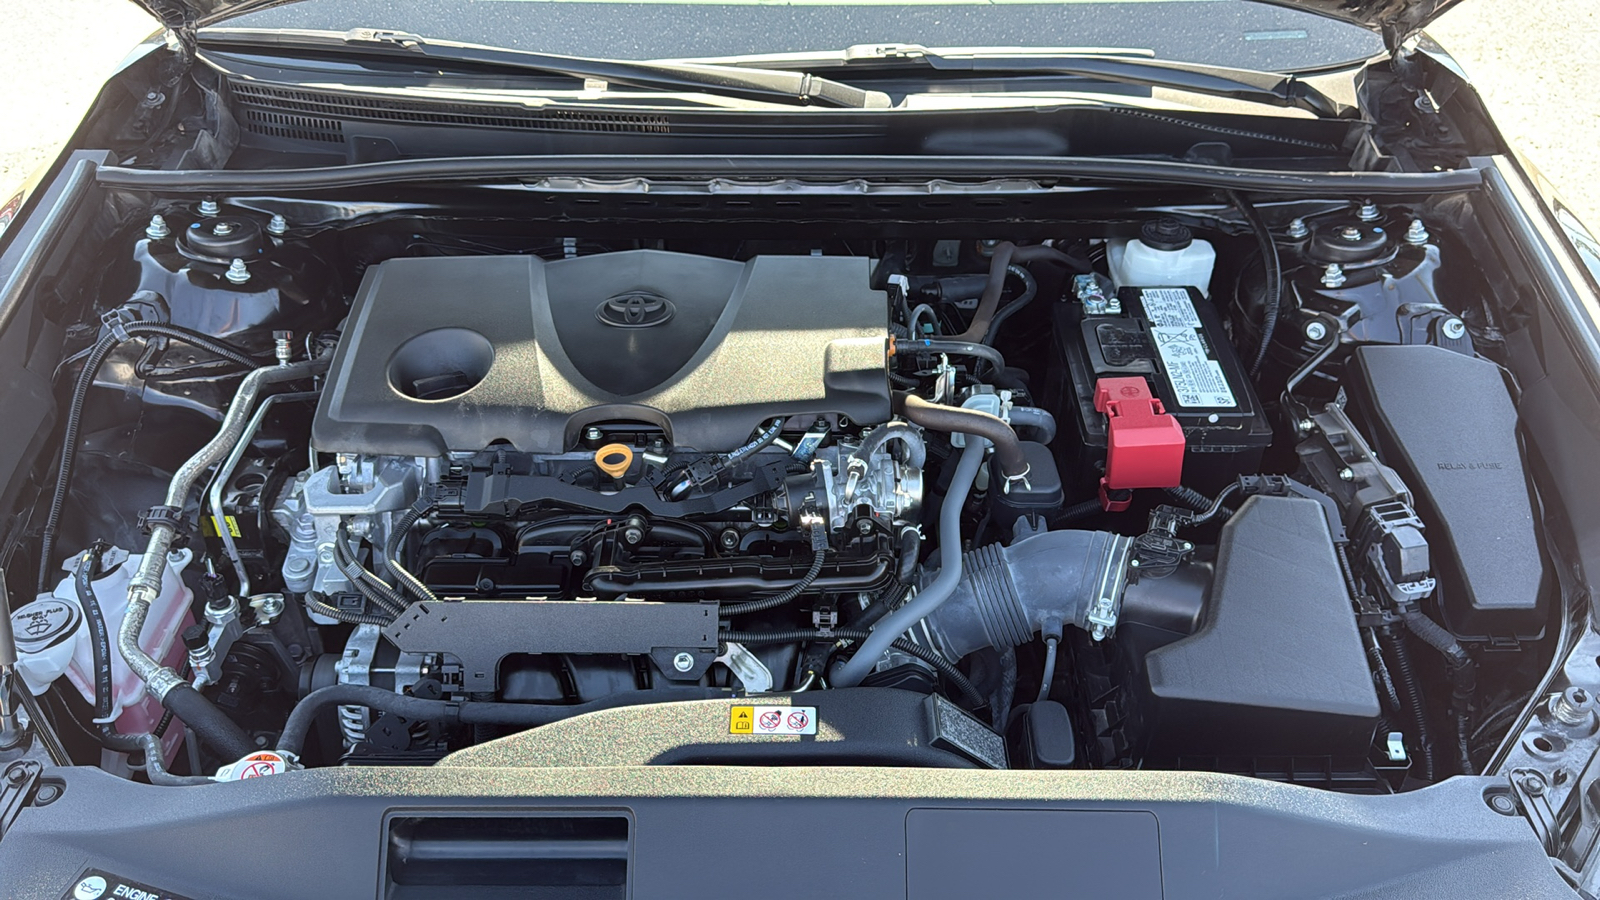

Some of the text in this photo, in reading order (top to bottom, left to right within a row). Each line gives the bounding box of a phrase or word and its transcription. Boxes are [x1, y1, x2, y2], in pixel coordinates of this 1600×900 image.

[1437, 462, 1466, 471] RELAY
[1476, 462, 1503, 471] FUSE
[113, 883, 159, 900] ENGINE
